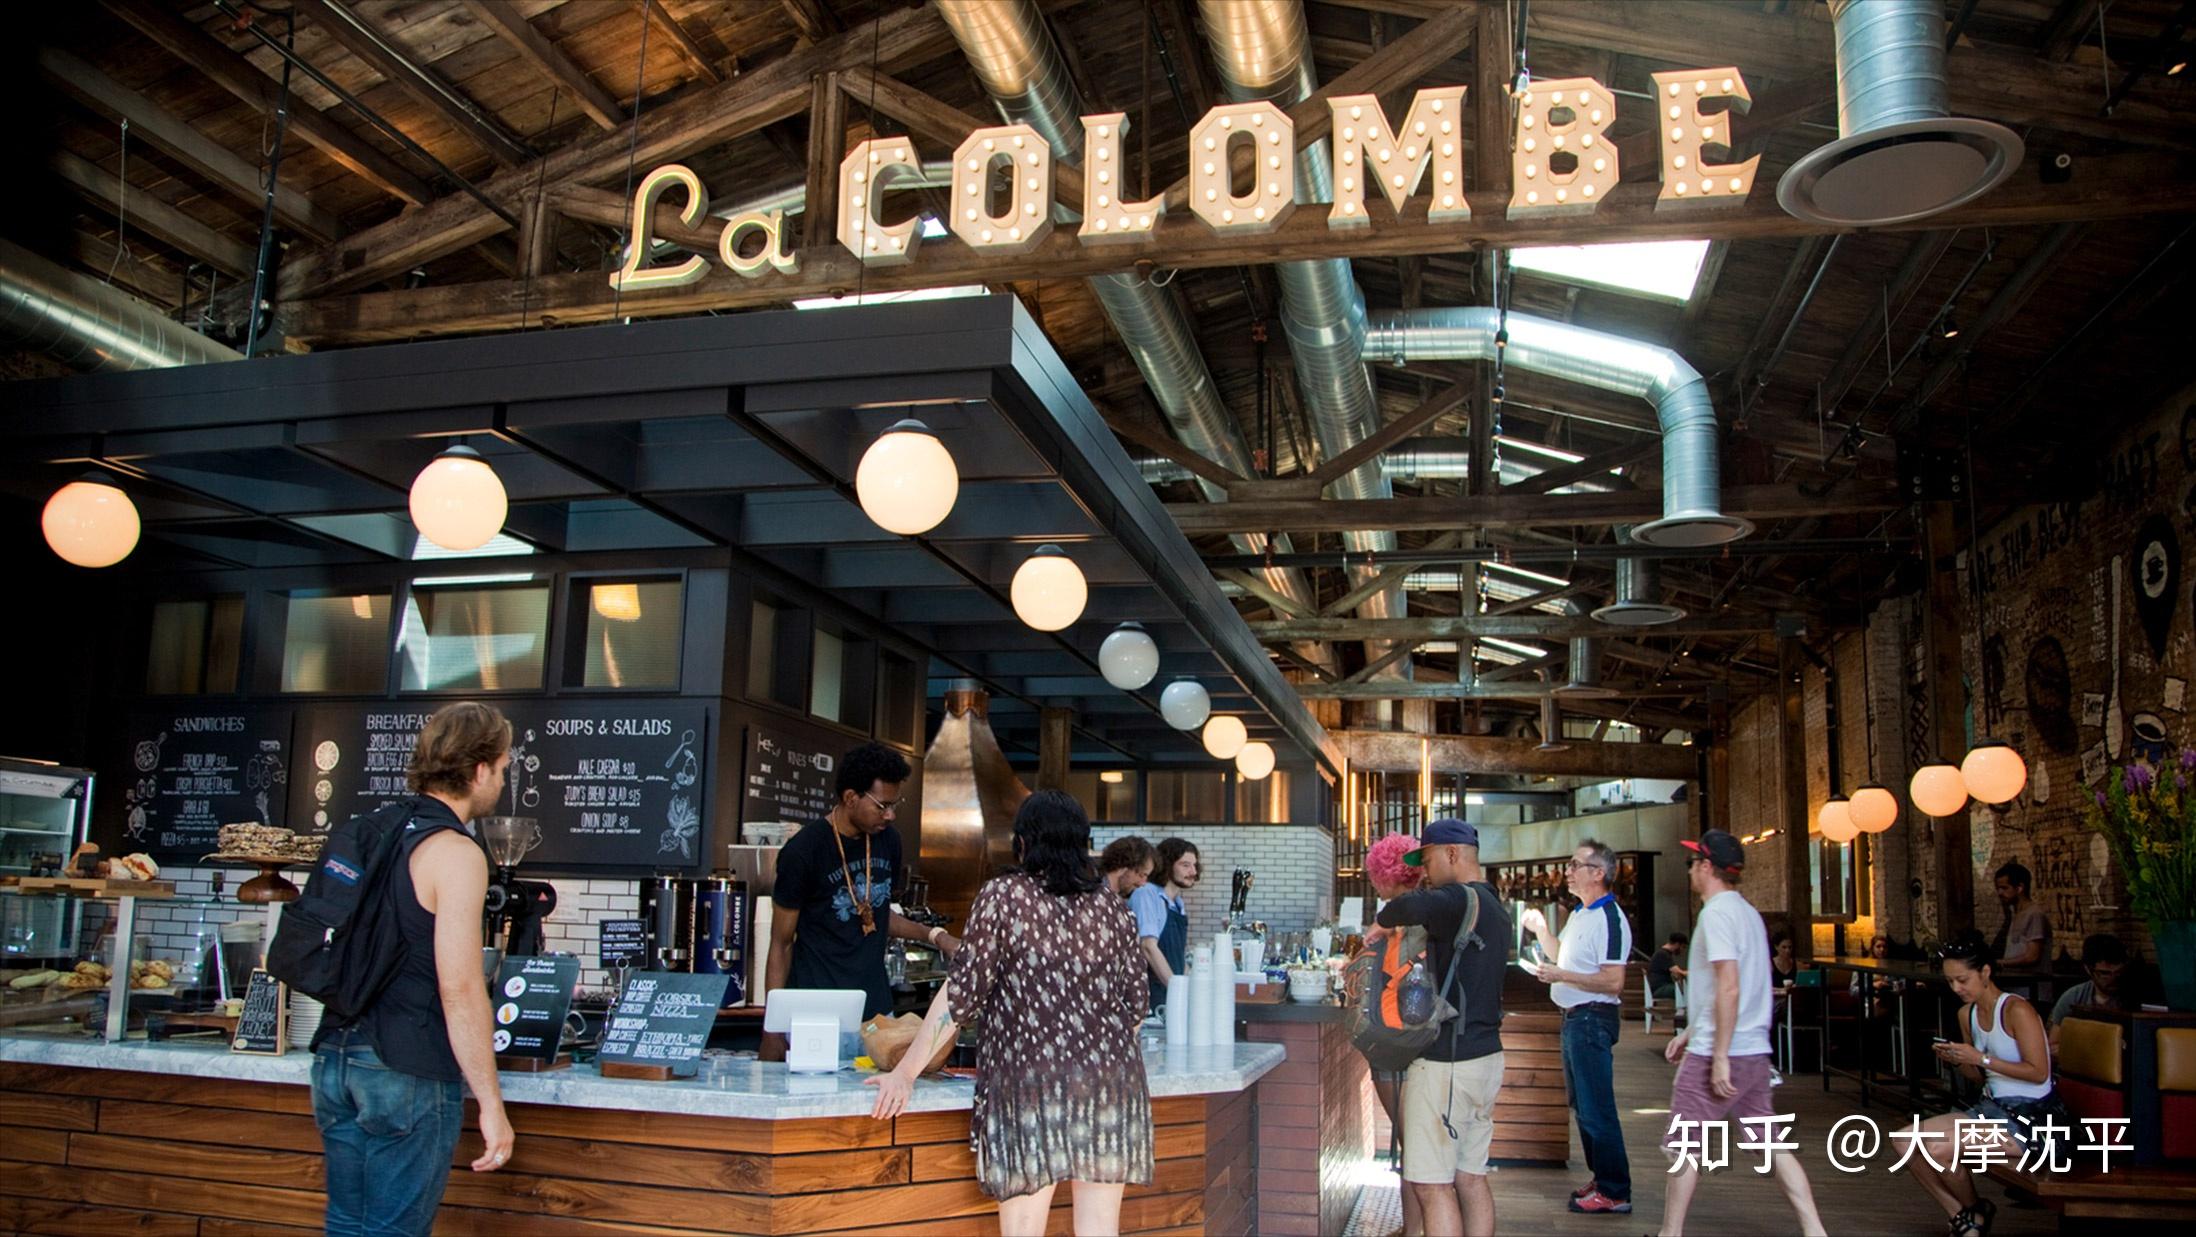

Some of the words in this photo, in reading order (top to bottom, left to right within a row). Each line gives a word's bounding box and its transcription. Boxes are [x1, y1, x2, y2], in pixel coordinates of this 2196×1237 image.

[609, 163, 801, 292] La
[837, 65, 1761, 267] COLOMBE
[173, 716, 246, 732] SANDWICHES
[366, 714, 433, 730] BREAKFAS
[546, 719, 594, 736] SOUPS
[598, 719, 608, 735] &
[612, 719, 672, 736] SALADS
[578, 759, 595, 774] KALE
[608, 785, 627, 801] SALAD
[581, 812, 601, 828] ONION
[602, 812, 618, 828] SOUP
[655, 992, 702, 1005] CORSICA
[652, 1004, 689, 1016] NIZZA
